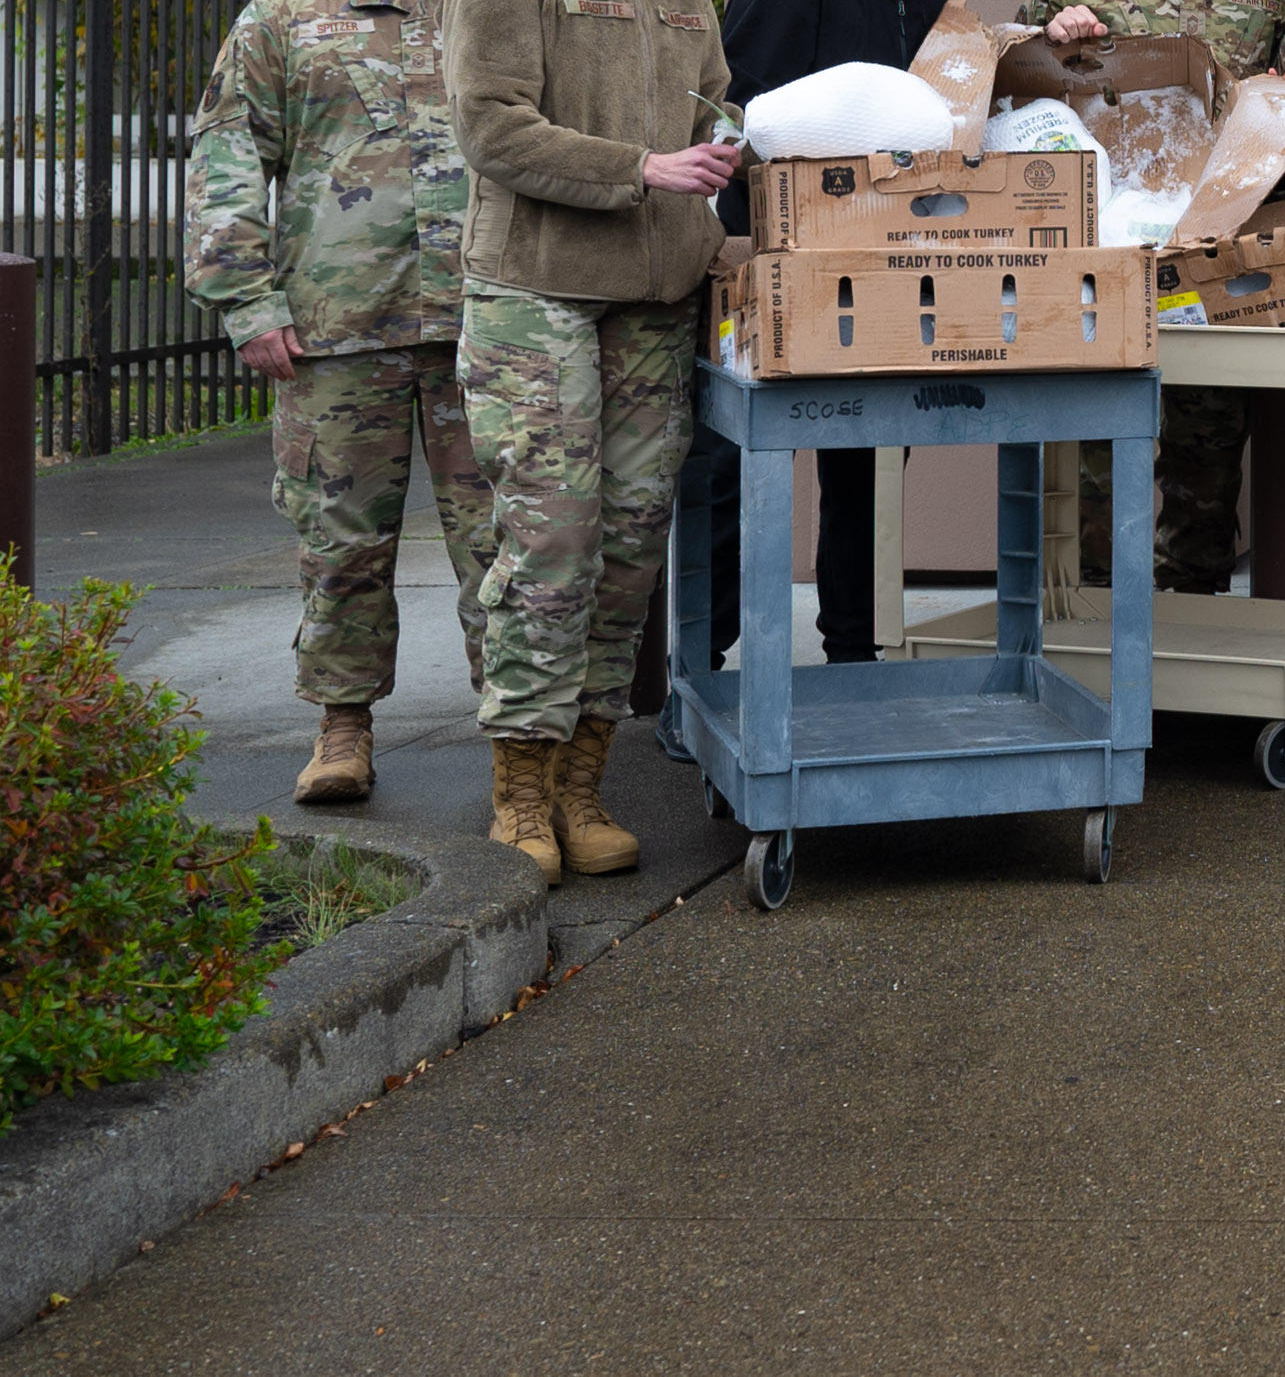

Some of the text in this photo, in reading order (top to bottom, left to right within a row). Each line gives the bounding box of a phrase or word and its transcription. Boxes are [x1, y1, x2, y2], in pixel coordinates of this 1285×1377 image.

[317, 21, 358, 34] SPITZER
[834, 176, 843, 186] A
[779, 172, 790, 220] PRODUCT
[1087, 190, 1094, 204] OF
[782, 222, 790, 237] OF
[888, 228, 1015, 242] READY TO COOK TURKEY
[888, 254, 1049, 269] READY TO COOK TURKEY
[771, 259, 784, 359] PRODUCT OF U.S.A.
[1145, 306, 1151, 319] OF
[1213, 309, 1241, 323] READY
[1242, 305, 1254, 316] TO
[1256, 300, 1279, 313] COOK
[931, 348, 1008, 363] PERISHABLE
